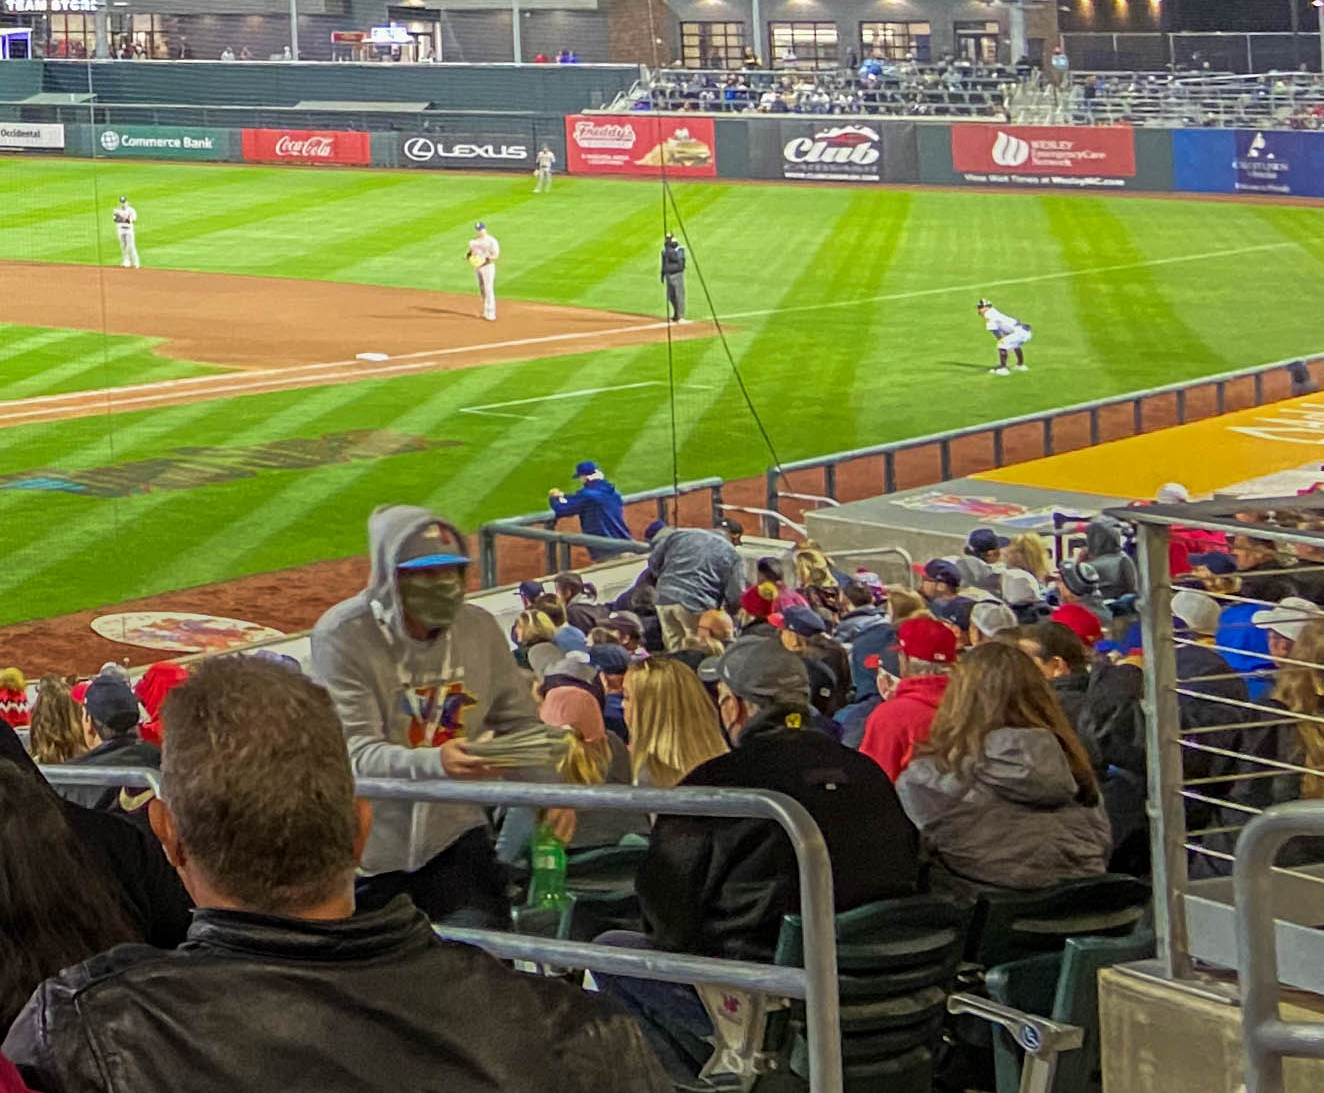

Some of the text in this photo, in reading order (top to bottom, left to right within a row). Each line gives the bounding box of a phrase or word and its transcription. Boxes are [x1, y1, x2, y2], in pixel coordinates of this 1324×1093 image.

[0, 128, 41, 138] Occidental
[121, 135, 214, 149] Commerce Bank
[437, 144, 527, 159] LEXUS
[783, 137, 880, 164] Club
